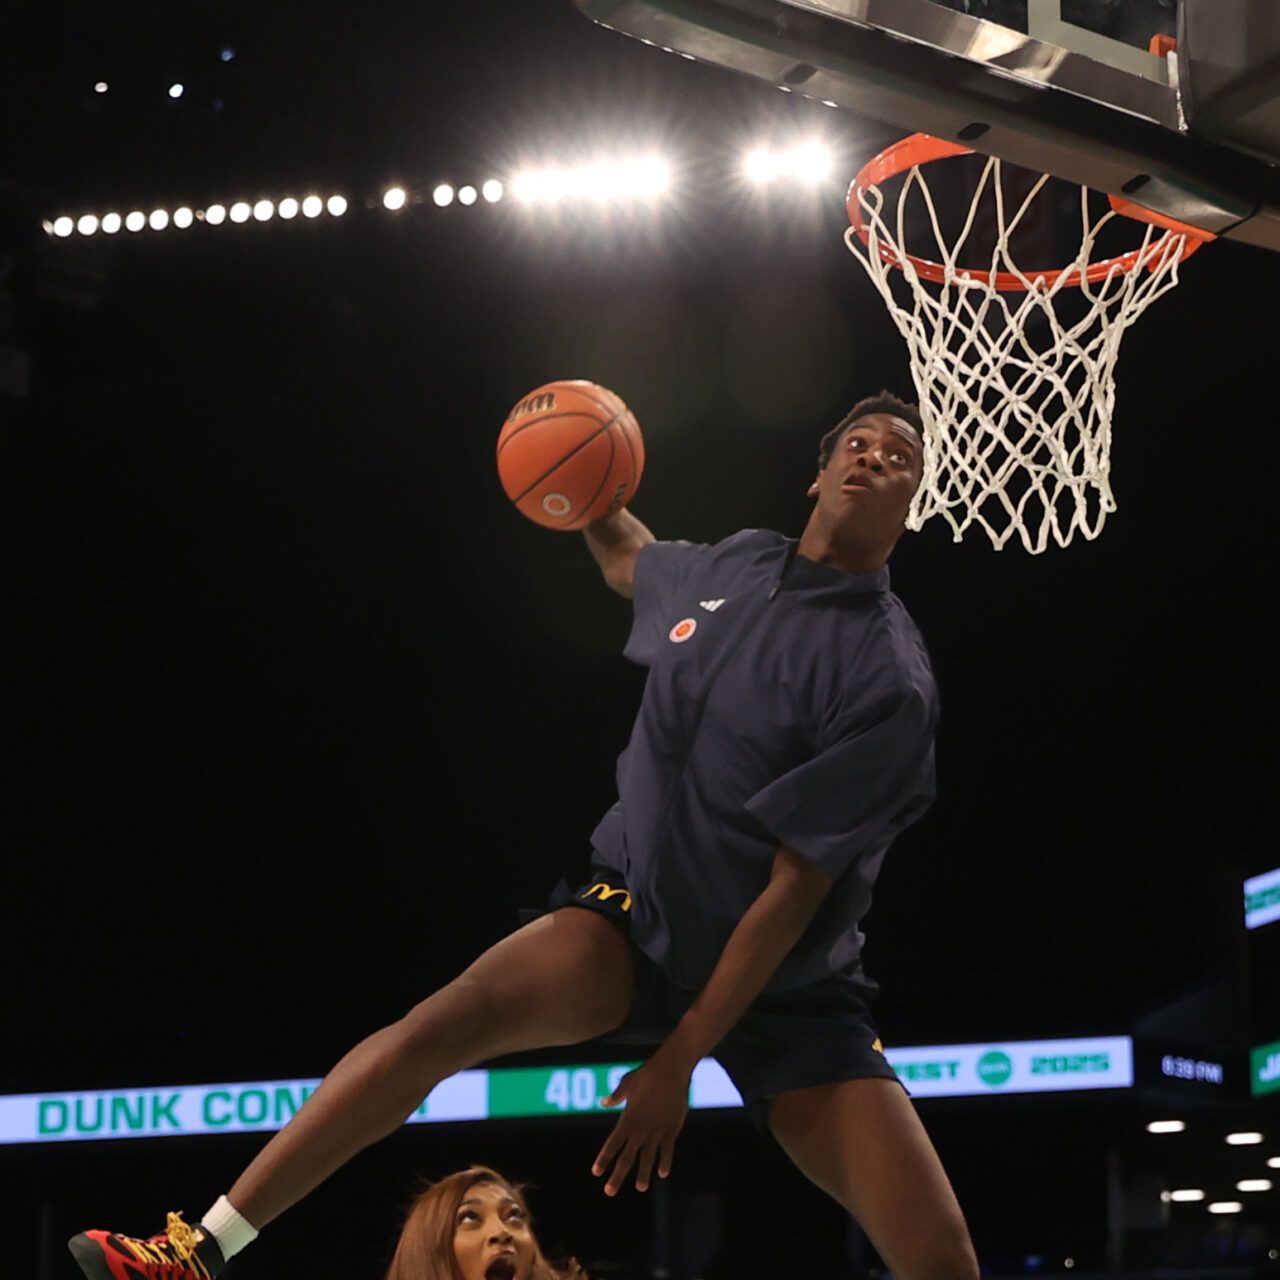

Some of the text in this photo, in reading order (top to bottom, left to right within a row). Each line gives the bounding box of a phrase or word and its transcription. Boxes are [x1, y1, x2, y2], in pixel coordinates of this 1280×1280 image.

[1029, 1051, 1110, 1075] 2025
[37, 1085, 312, 1135] DUNK CON
